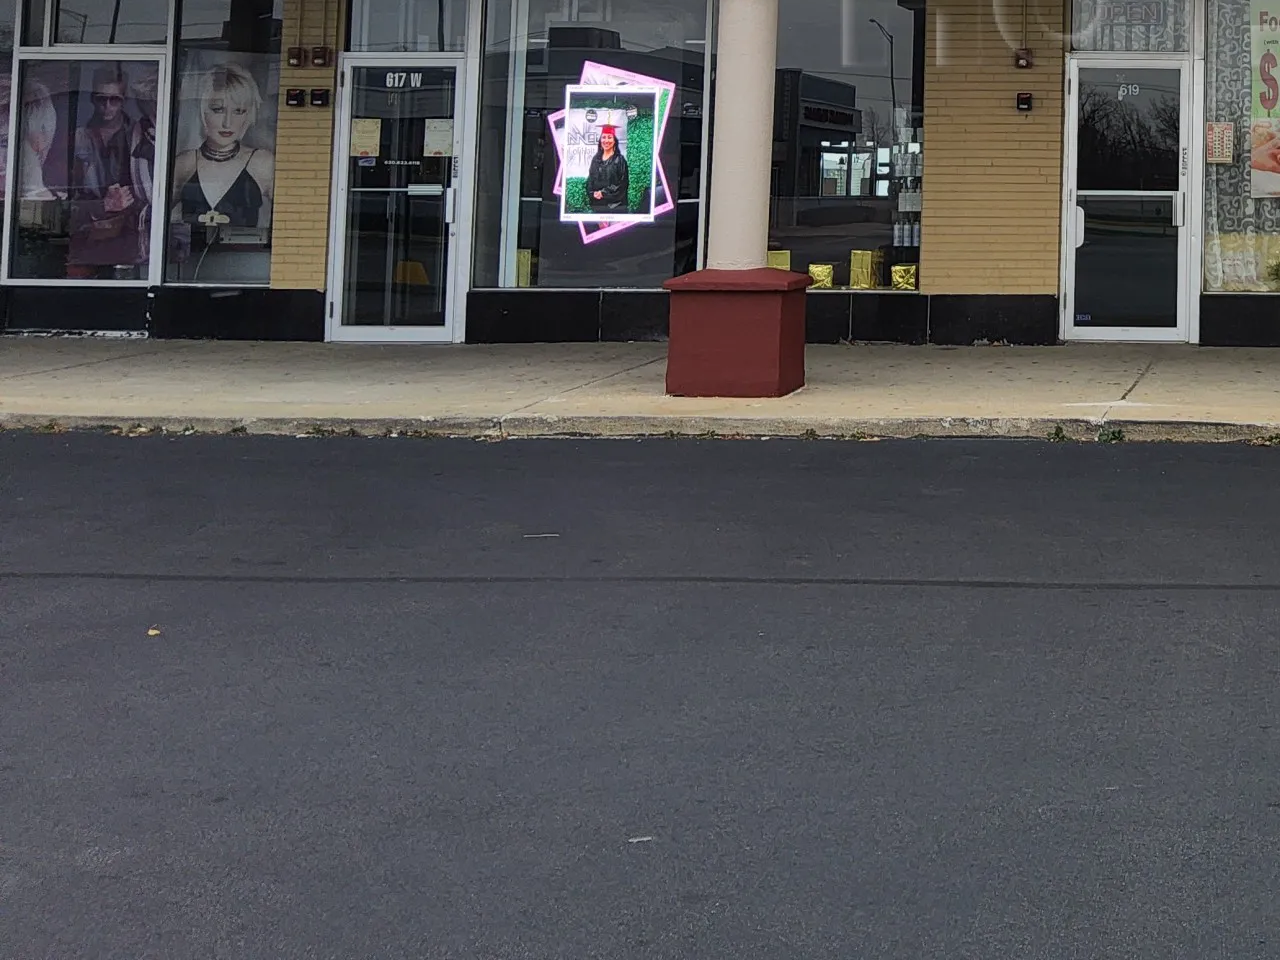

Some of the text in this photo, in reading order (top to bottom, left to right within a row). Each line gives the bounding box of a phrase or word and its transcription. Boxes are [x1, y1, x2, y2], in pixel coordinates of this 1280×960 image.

[1093, 4, 1158, 21] OPEN
[385, 72, 422, 88] 617 W
[1119, 84, 1140, 96] 619
